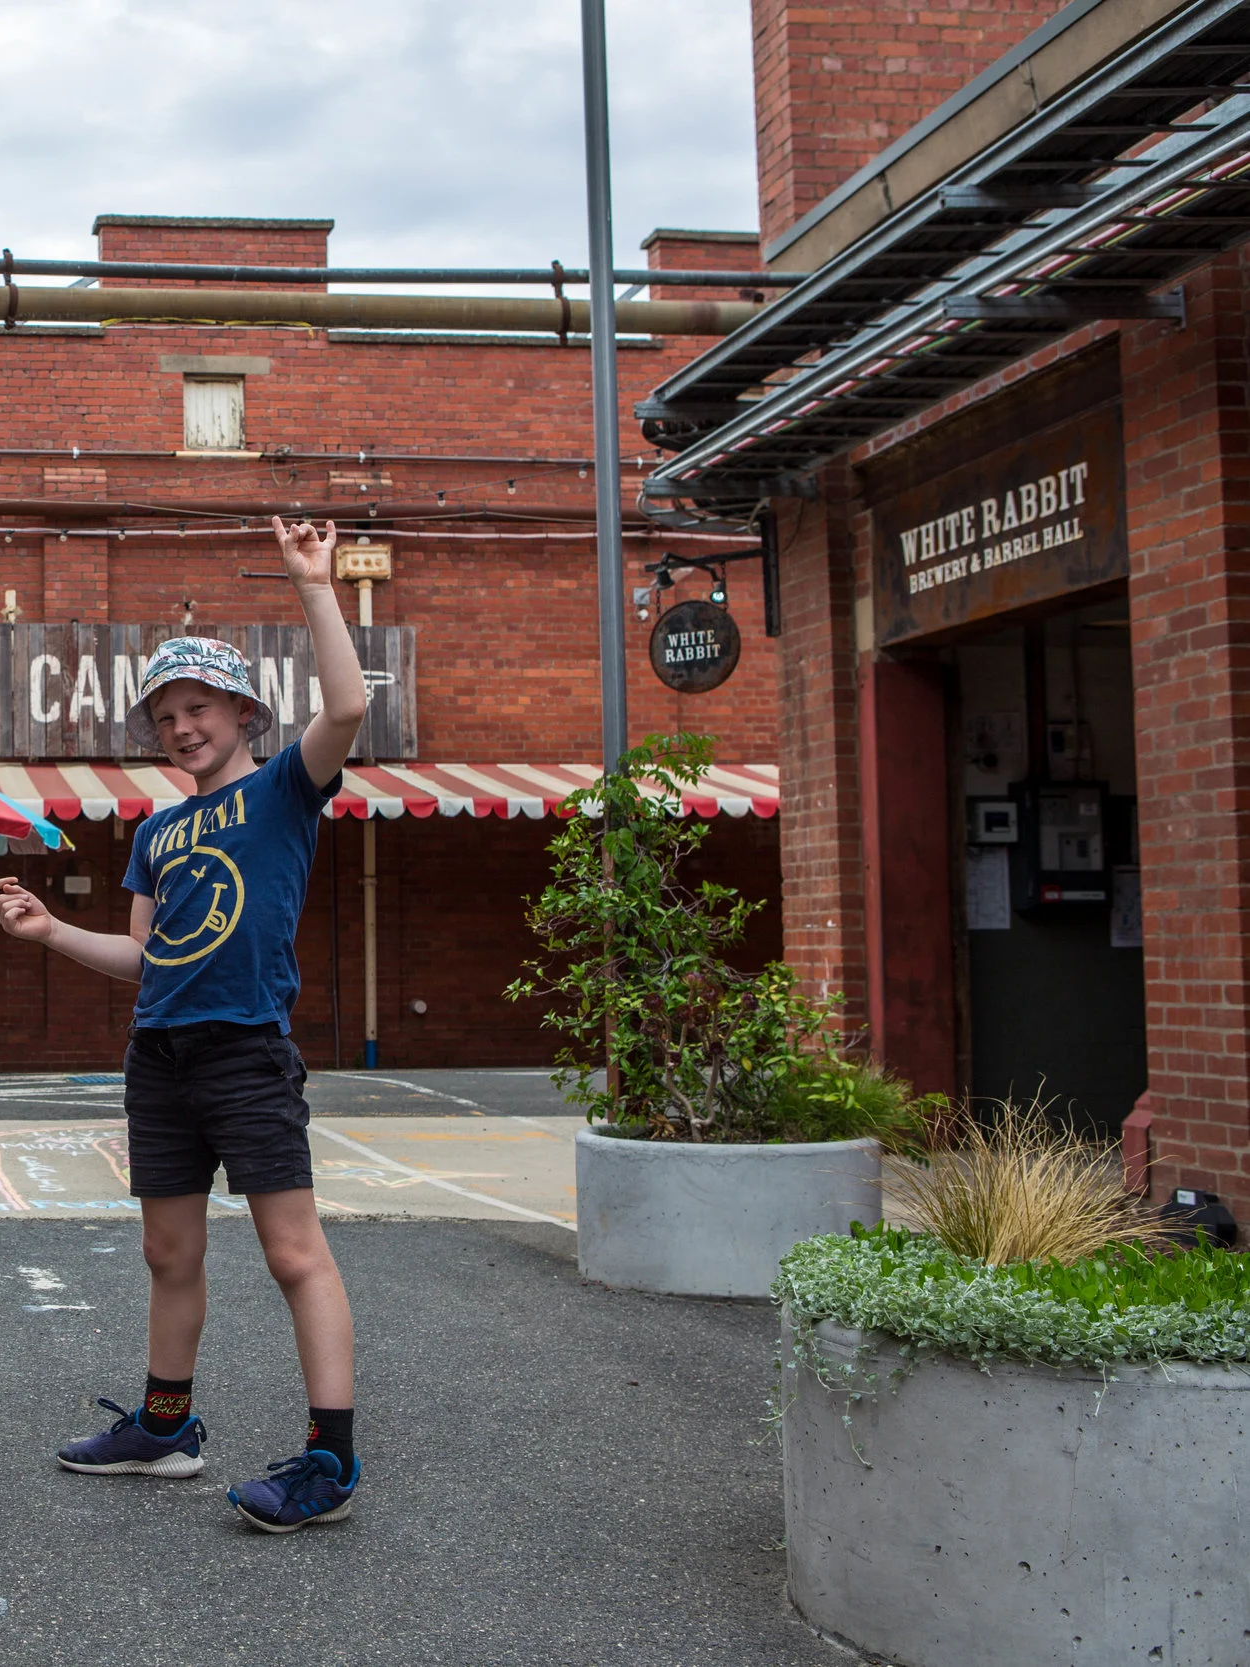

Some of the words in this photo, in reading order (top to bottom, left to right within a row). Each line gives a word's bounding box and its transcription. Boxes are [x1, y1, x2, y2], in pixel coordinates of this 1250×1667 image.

[900, 505, 976, 567] WHITE
[980, 461, 1089, 539] RABBIT
[909, 556, 969, 595] BREWERY
[969, 552, 981, 574] &
[983, 531, 1041, 570] BARREL
[1042, 517, 1084, 550] HALL
[664, 644, 721, 664] RABBIT
[667, 629, 715, 648] WHITE
[30, 654, 295, 724] CANN
[149, 1403, 185, 1414] CRUZ
